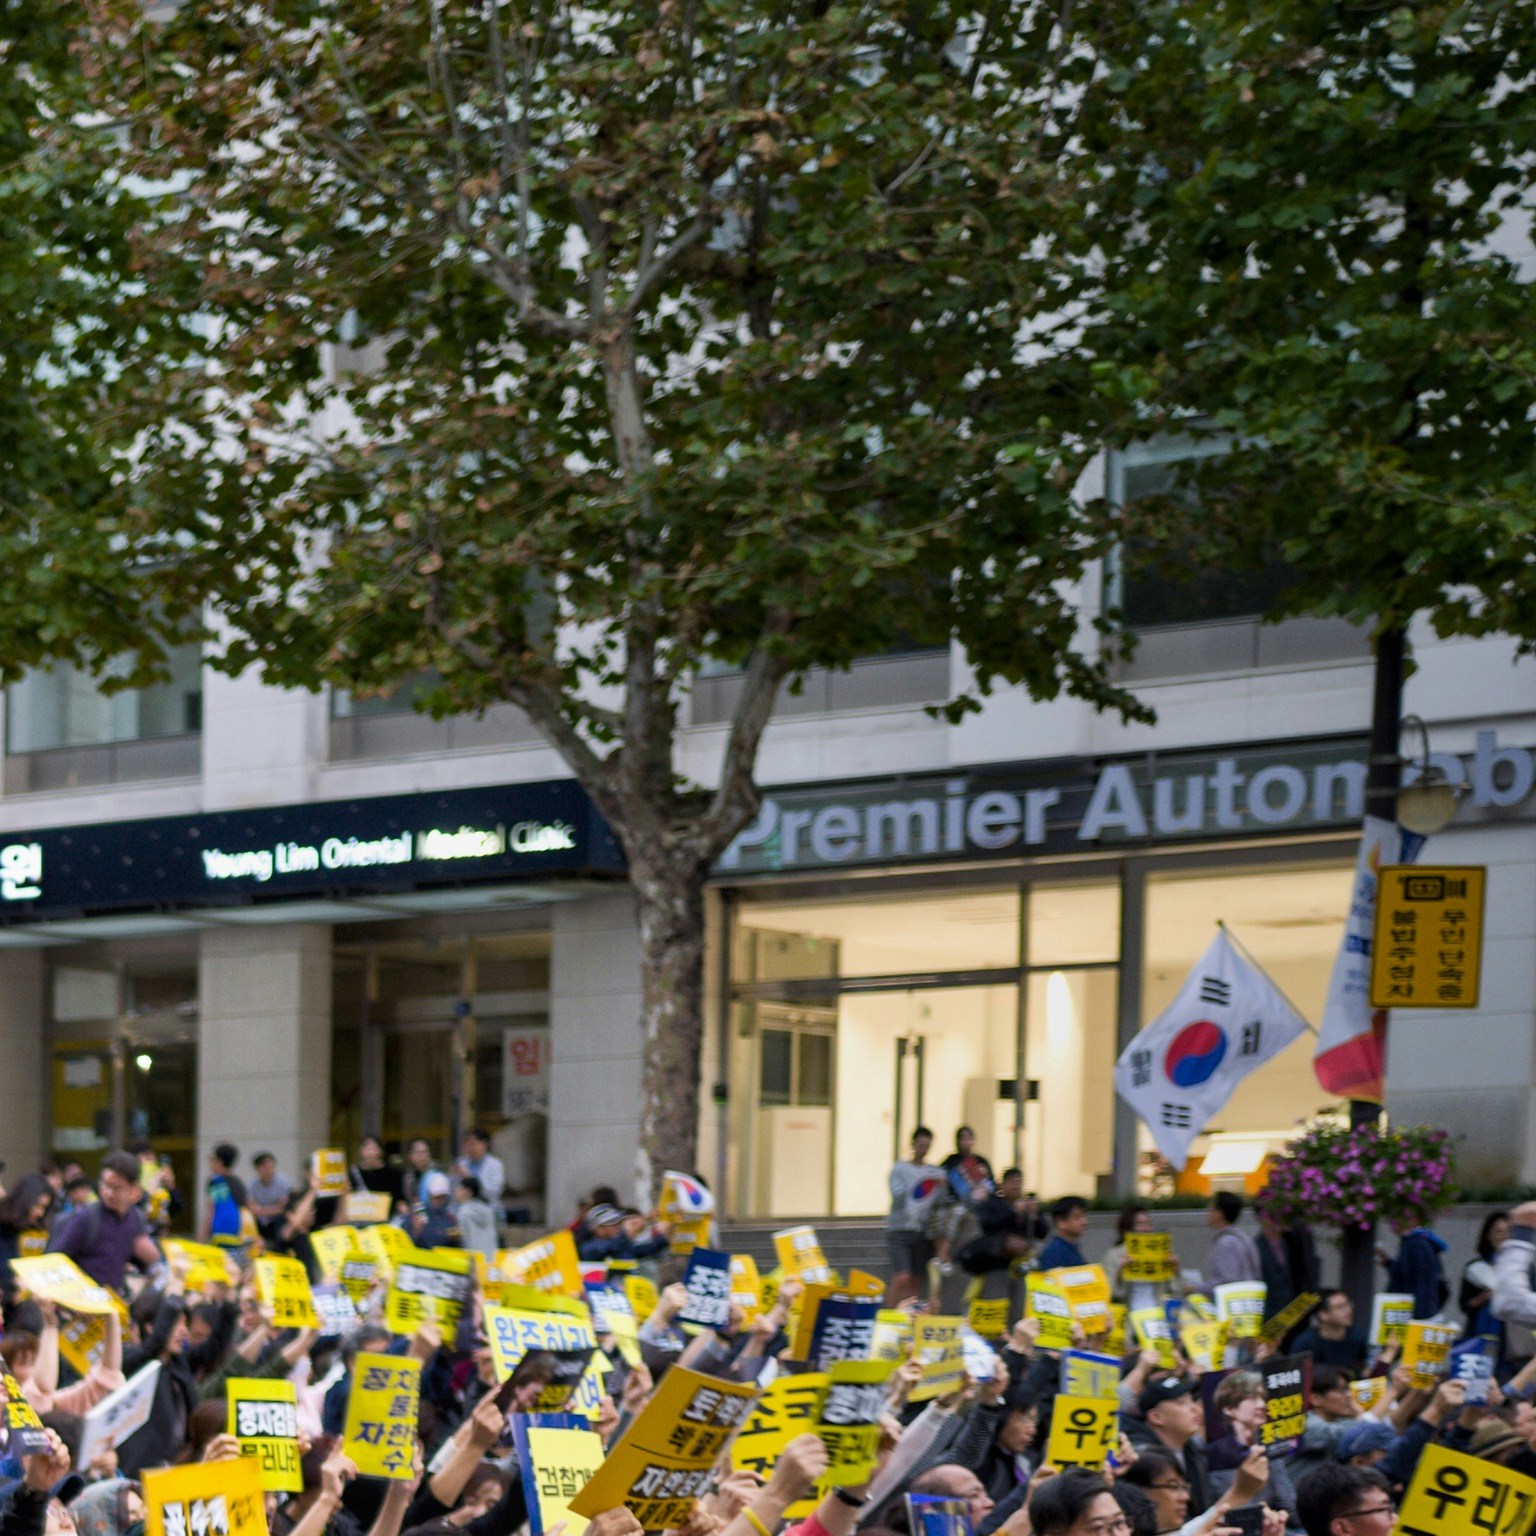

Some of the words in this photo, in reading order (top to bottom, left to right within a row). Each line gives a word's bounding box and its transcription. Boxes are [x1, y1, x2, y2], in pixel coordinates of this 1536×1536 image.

[201, 846, 274, 882] Young
[275, 841, 319, 874] Lim
[322, 829, 413, 869] Oriental
[720, 781, 1060, 869] Premier
